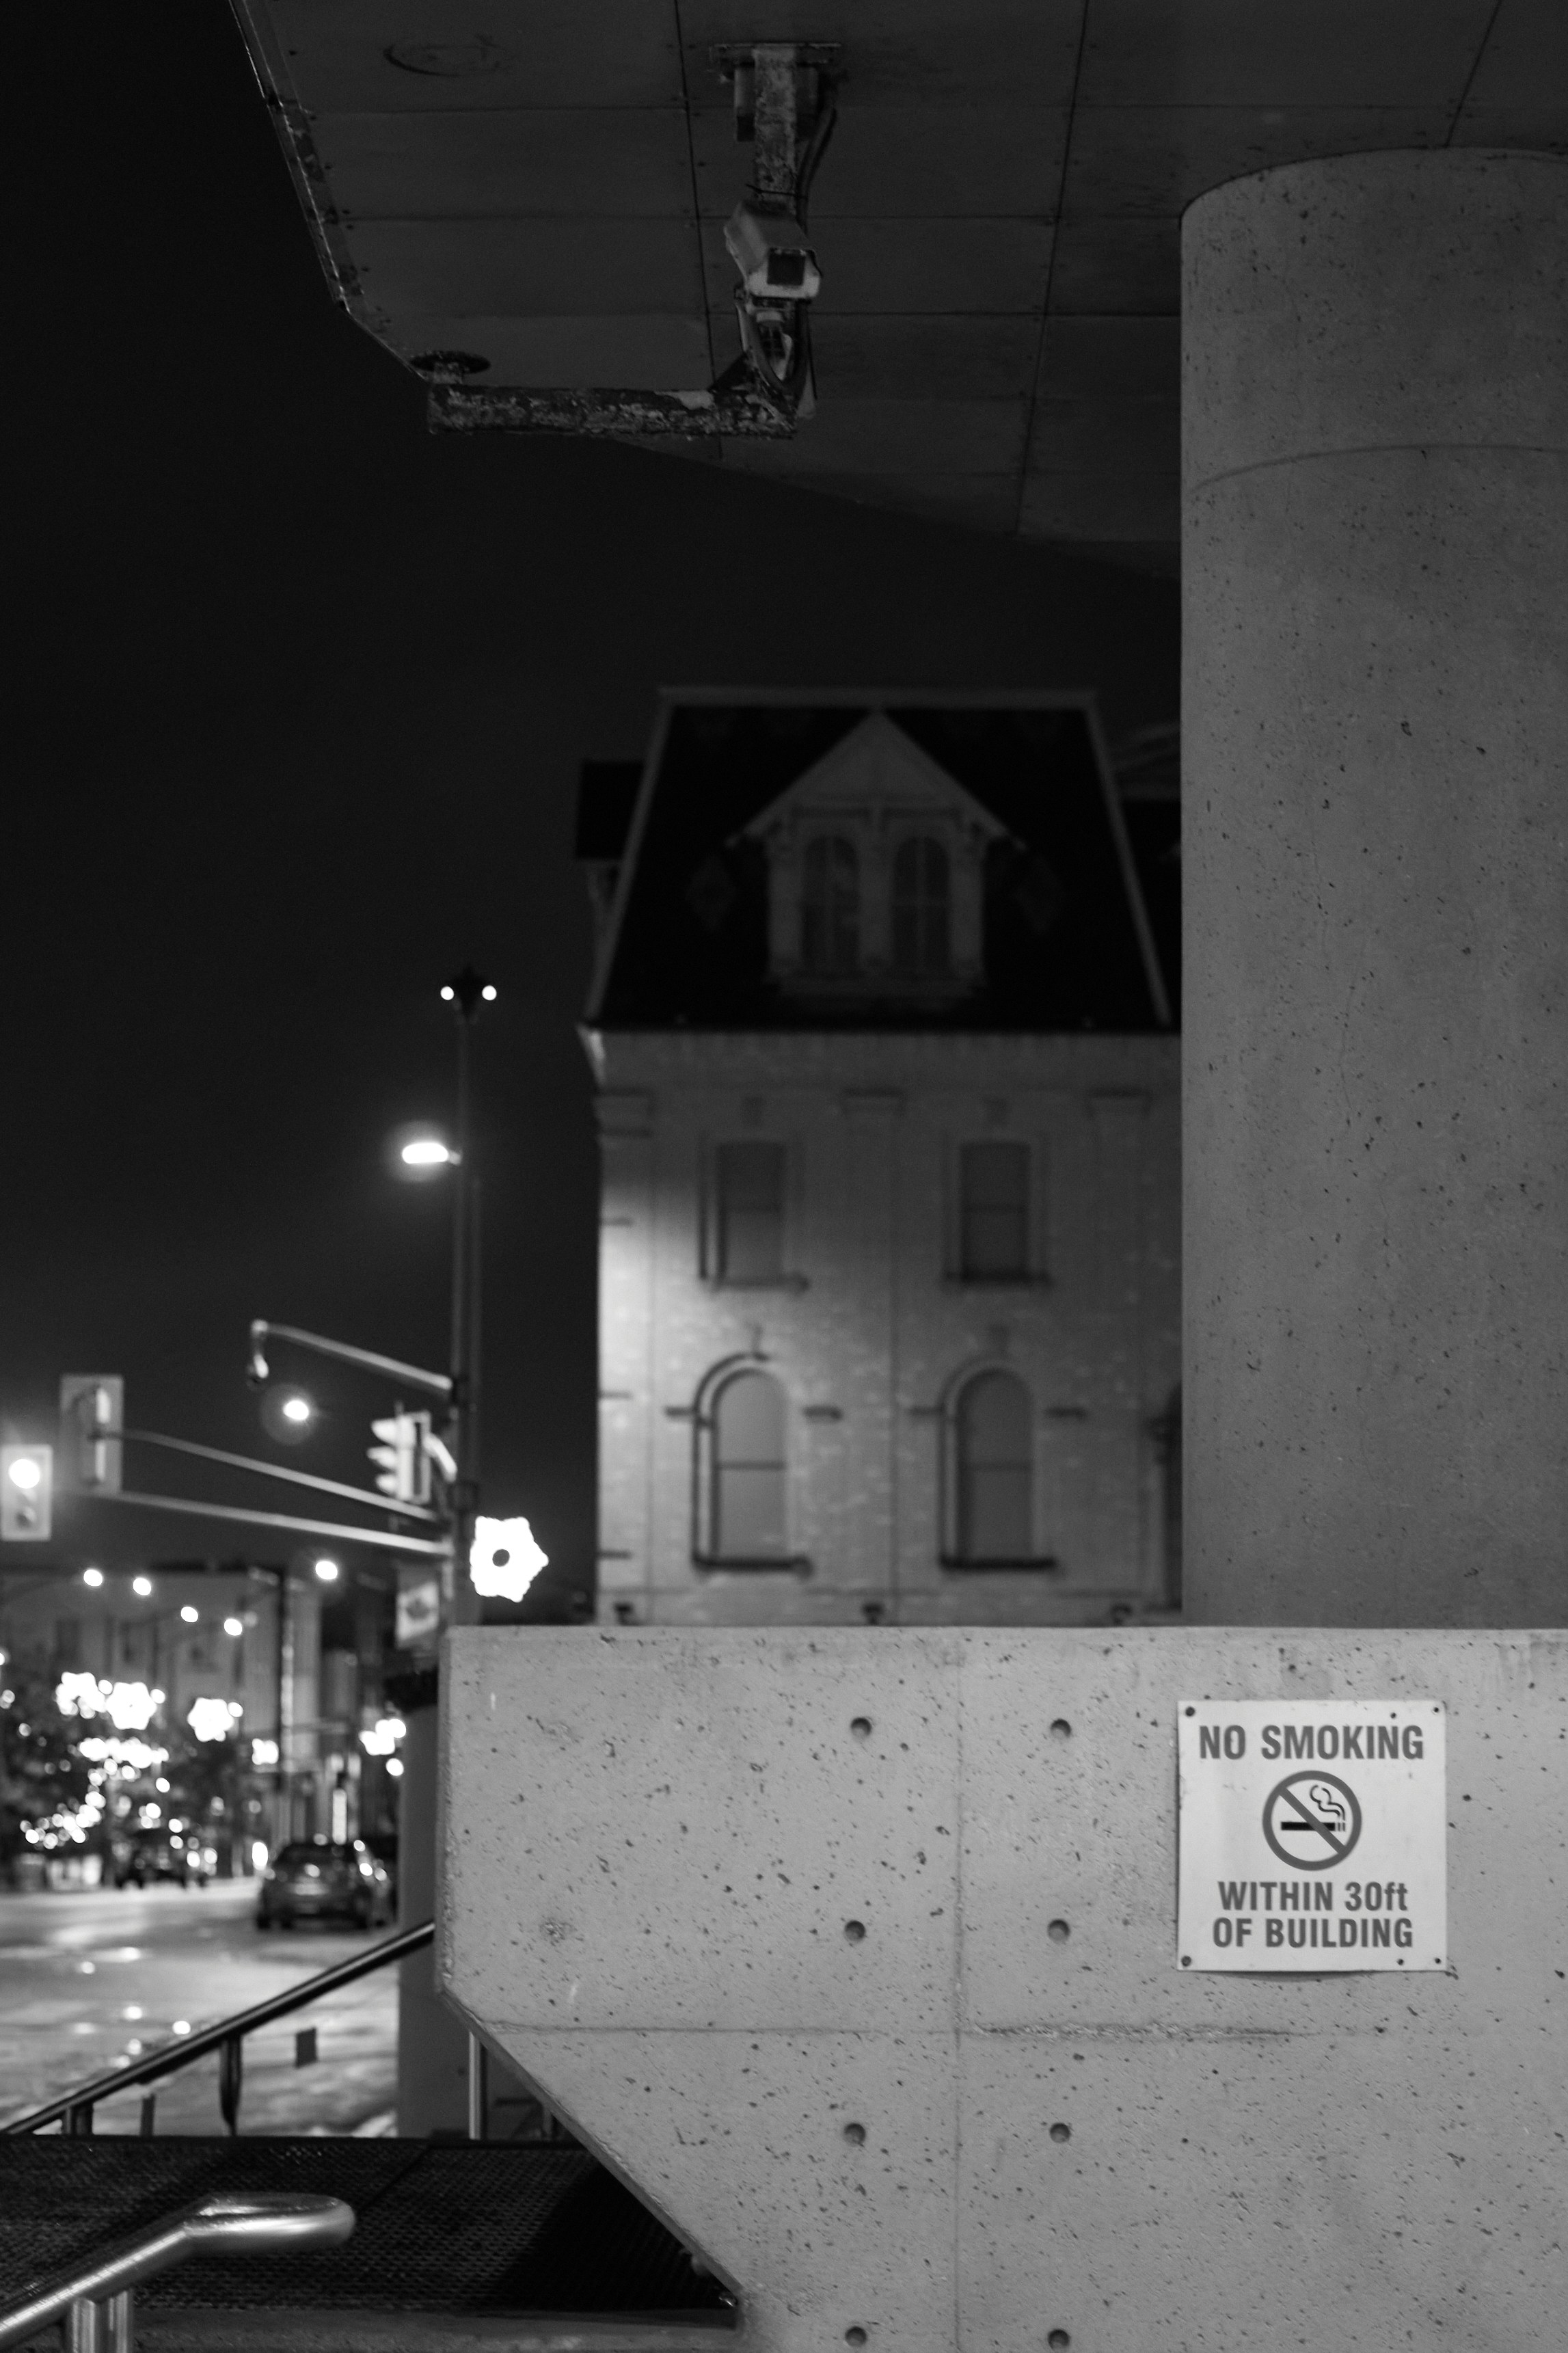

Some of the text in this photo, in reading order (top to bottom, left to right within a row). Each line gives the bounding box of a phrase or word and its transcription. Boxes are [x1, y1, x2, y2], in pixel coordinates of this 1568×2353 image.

[1200, 1725, 1424, 1760] NO SMOKING
[1217, 1881, 1408, 1911] WITHIN 30ft
[1213, 1917, 1413, 1948] OF BUILDING
